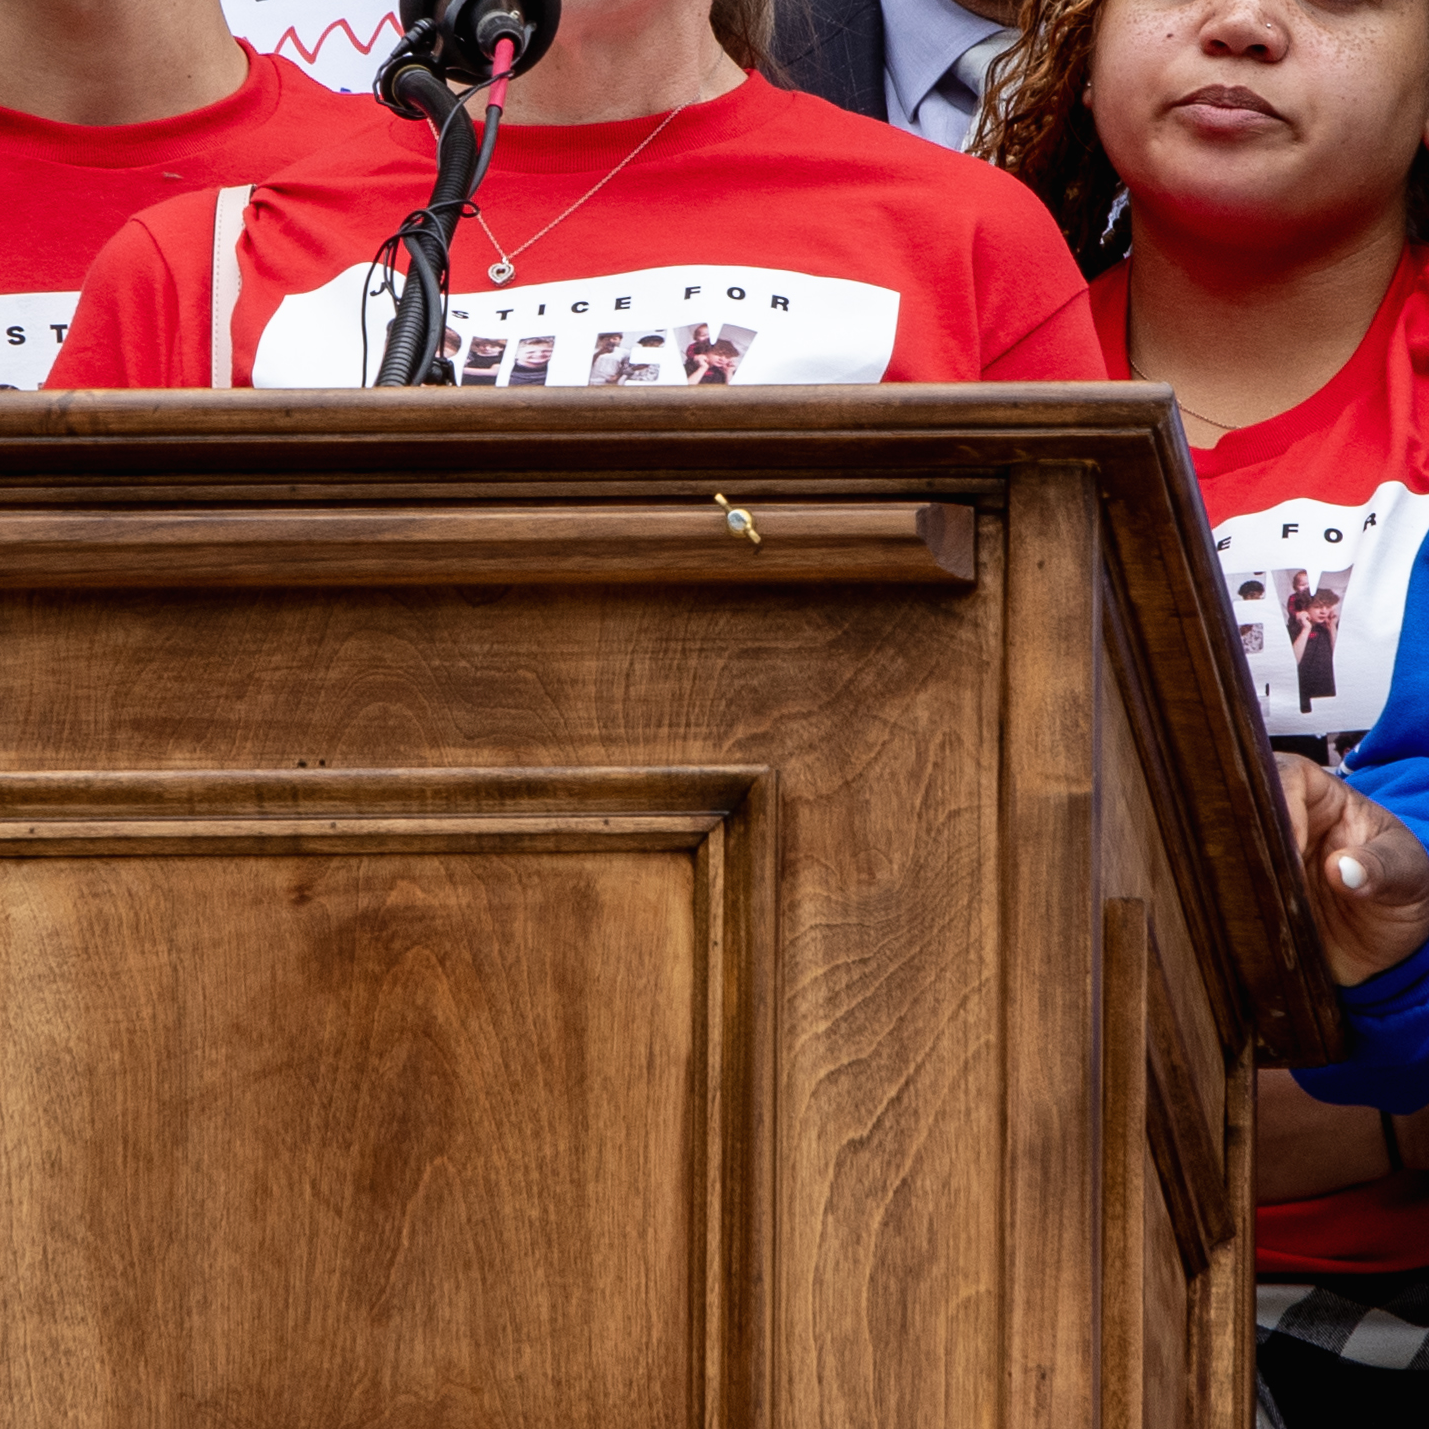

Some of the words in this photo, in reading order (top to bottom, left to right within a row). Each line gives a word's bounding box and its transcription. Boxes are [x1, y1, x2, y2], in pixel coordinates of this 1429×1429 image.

[369, 281, 632, 322] JSTICE
[684, 286, 791, 314] FOR
[1281, 512, 1378, 544] FOR
